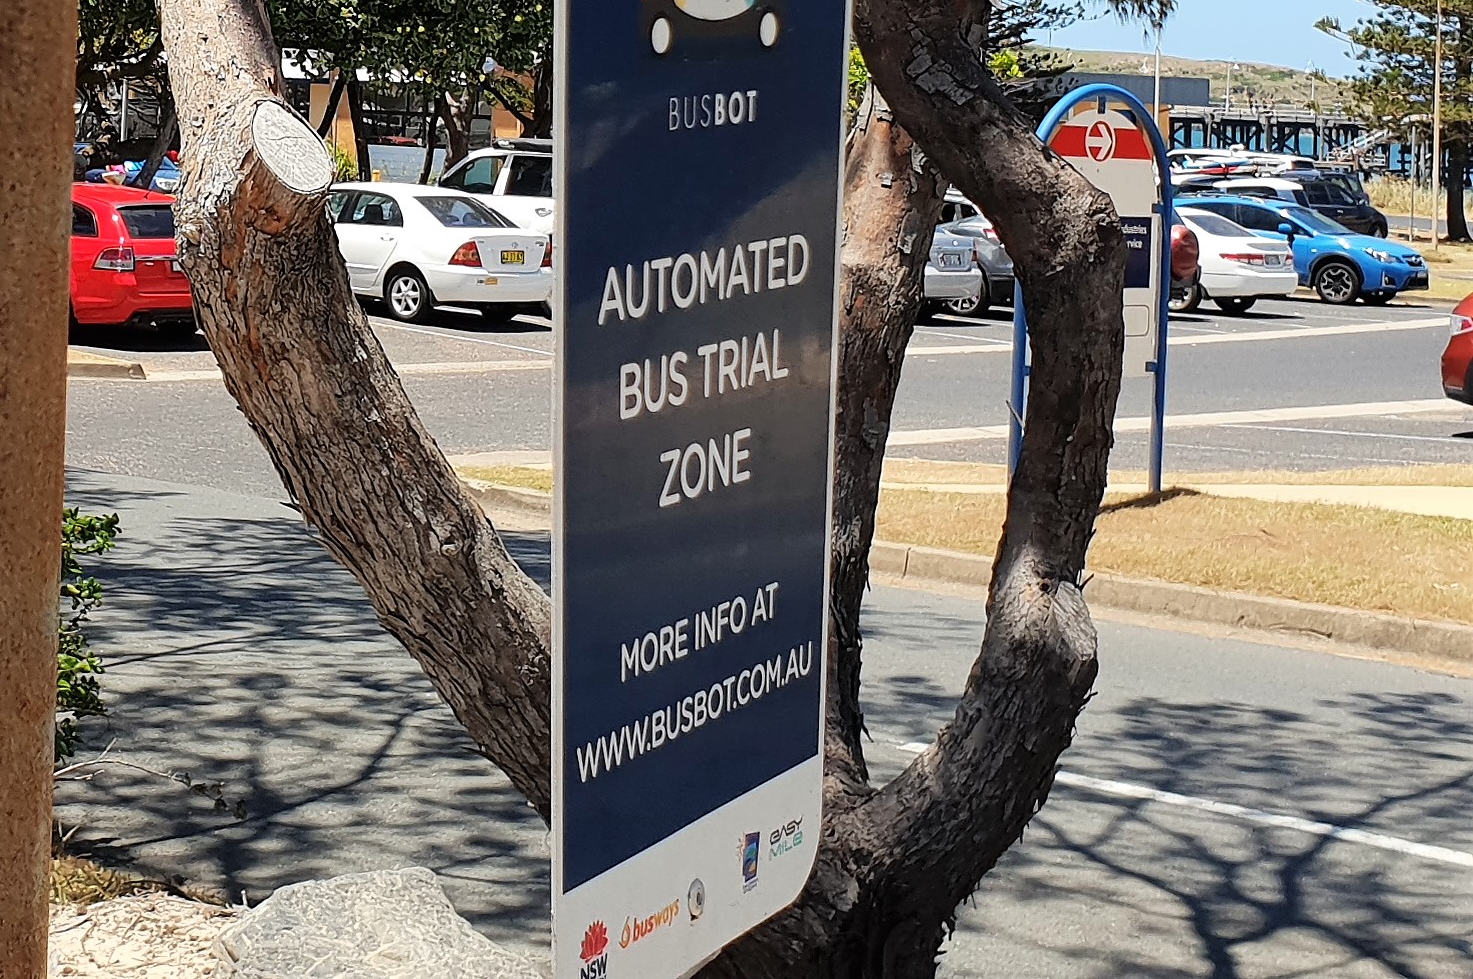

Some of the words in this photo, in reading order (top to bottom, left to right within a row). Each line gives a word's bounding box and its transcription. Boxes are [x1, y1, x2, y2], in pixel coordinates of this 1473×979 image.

[668, 90, 758, 131] BUSBOT
[598, 234, 810, 325] AUTOMATED
[619, 351, 688, 420] BUS
[697, 328, 789, 398] TRIAL
[659, 427, 751, 508] ZONE
[620, 618, 688, 682] MORE
[694, 596, 747, 649] INFO
[751, 582, 780, 627] AT
[577, 640, 813, 784] WWW.BUSBOT.COM.AU
[632, 899, 679, 942] busways
[580, 953, 608, 979] NSW
